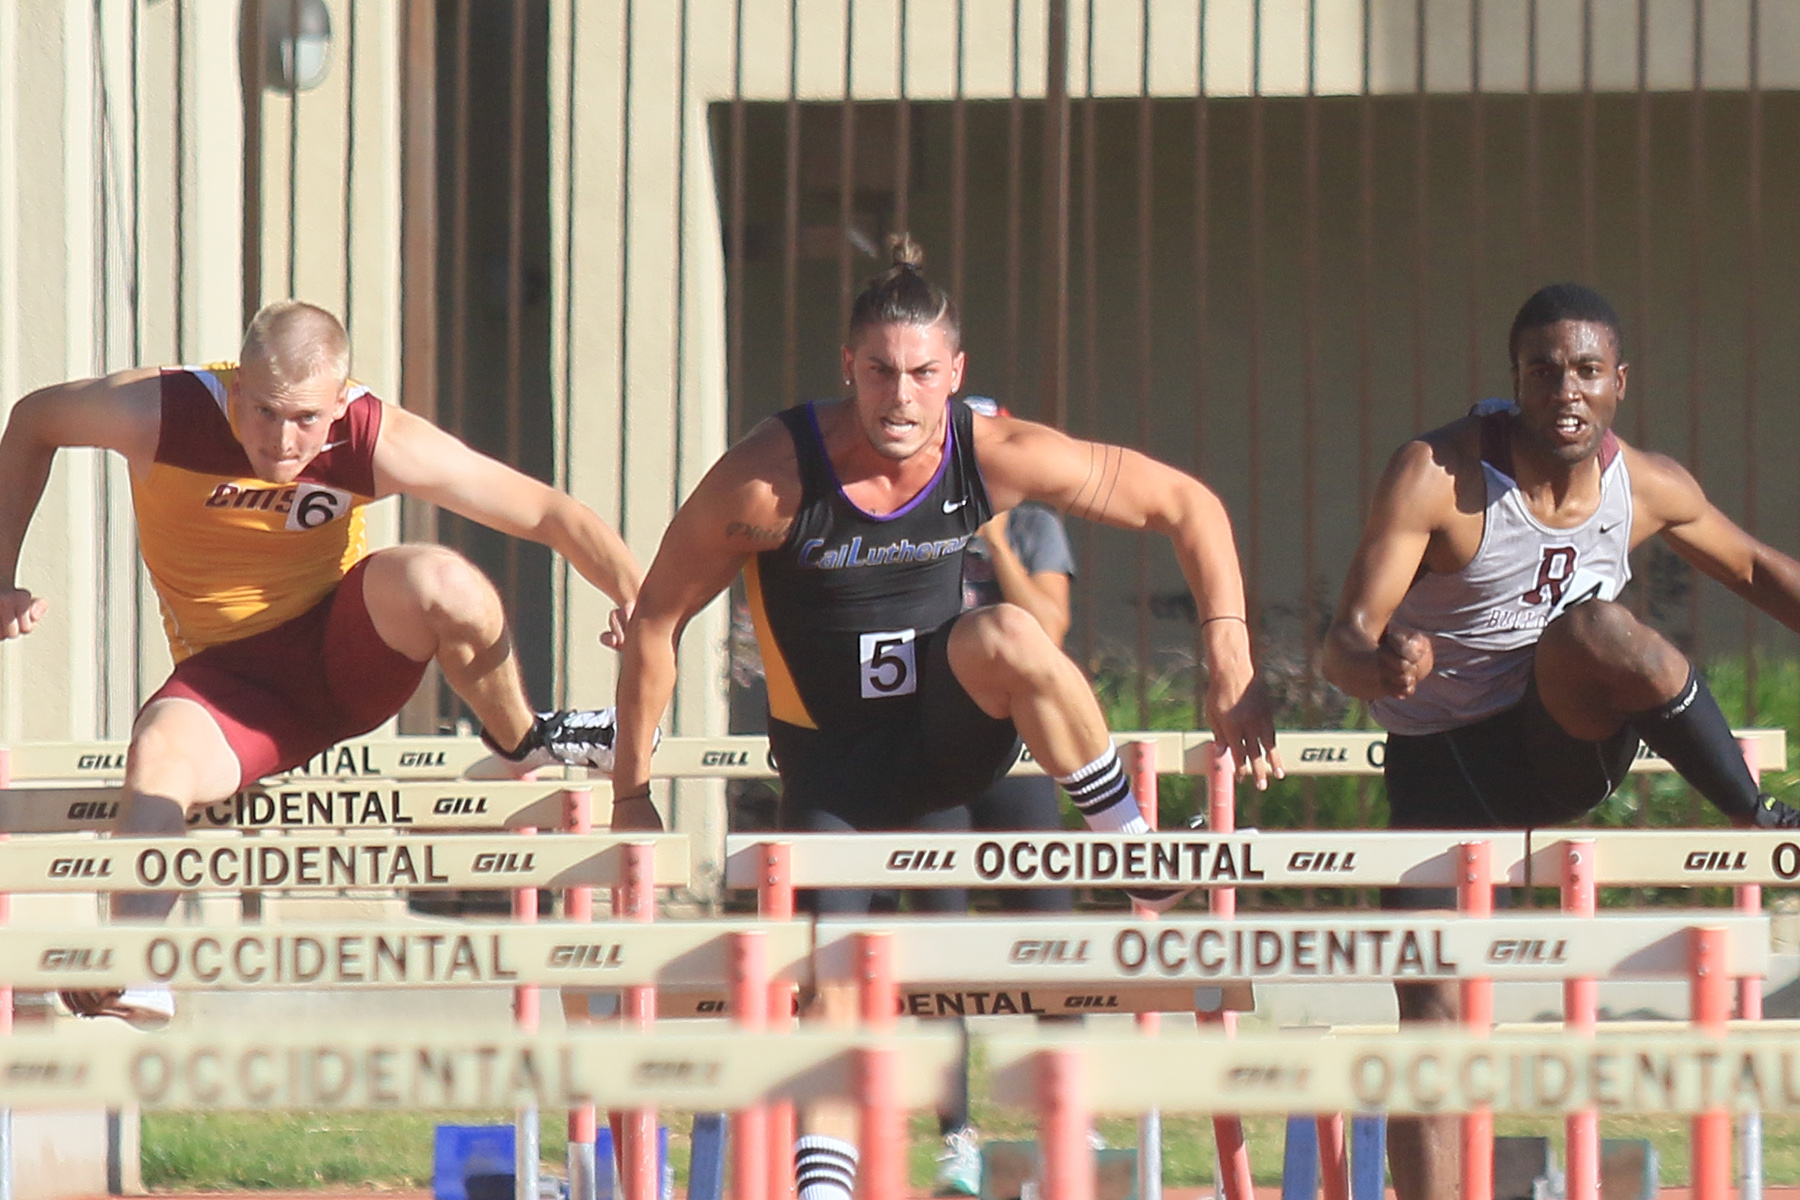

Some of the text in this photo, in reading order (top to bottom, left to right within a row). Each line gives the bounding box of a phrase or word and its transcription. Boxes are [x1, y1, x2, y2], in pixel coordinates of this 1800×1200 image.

[297, 491, 338, 529] 6
[869, 638, 907, 692] 5
[399, 752, 446, 766] GILL
[701, 750, 749, 766] GILL
[1301, 747, 1347, 762] GILL
[433, 797, 488, 814] GILL
[50, 846, 537, 887] GILL OCCIDENTAL GILL
[889, 841, 1358, 881] GILL OCCIDENTAL GILL
[1684, 851, 1748, 871] GILL
[40, 934, 624, 982] GILL OCCIDENTAL GILL
[1010, 927, 1569, 976] GILL OCCIDENTAL GILL
[1063, 995, 1119, 1008] GILL
[129, 1044, 592, 1101] OCCIDENTAL
